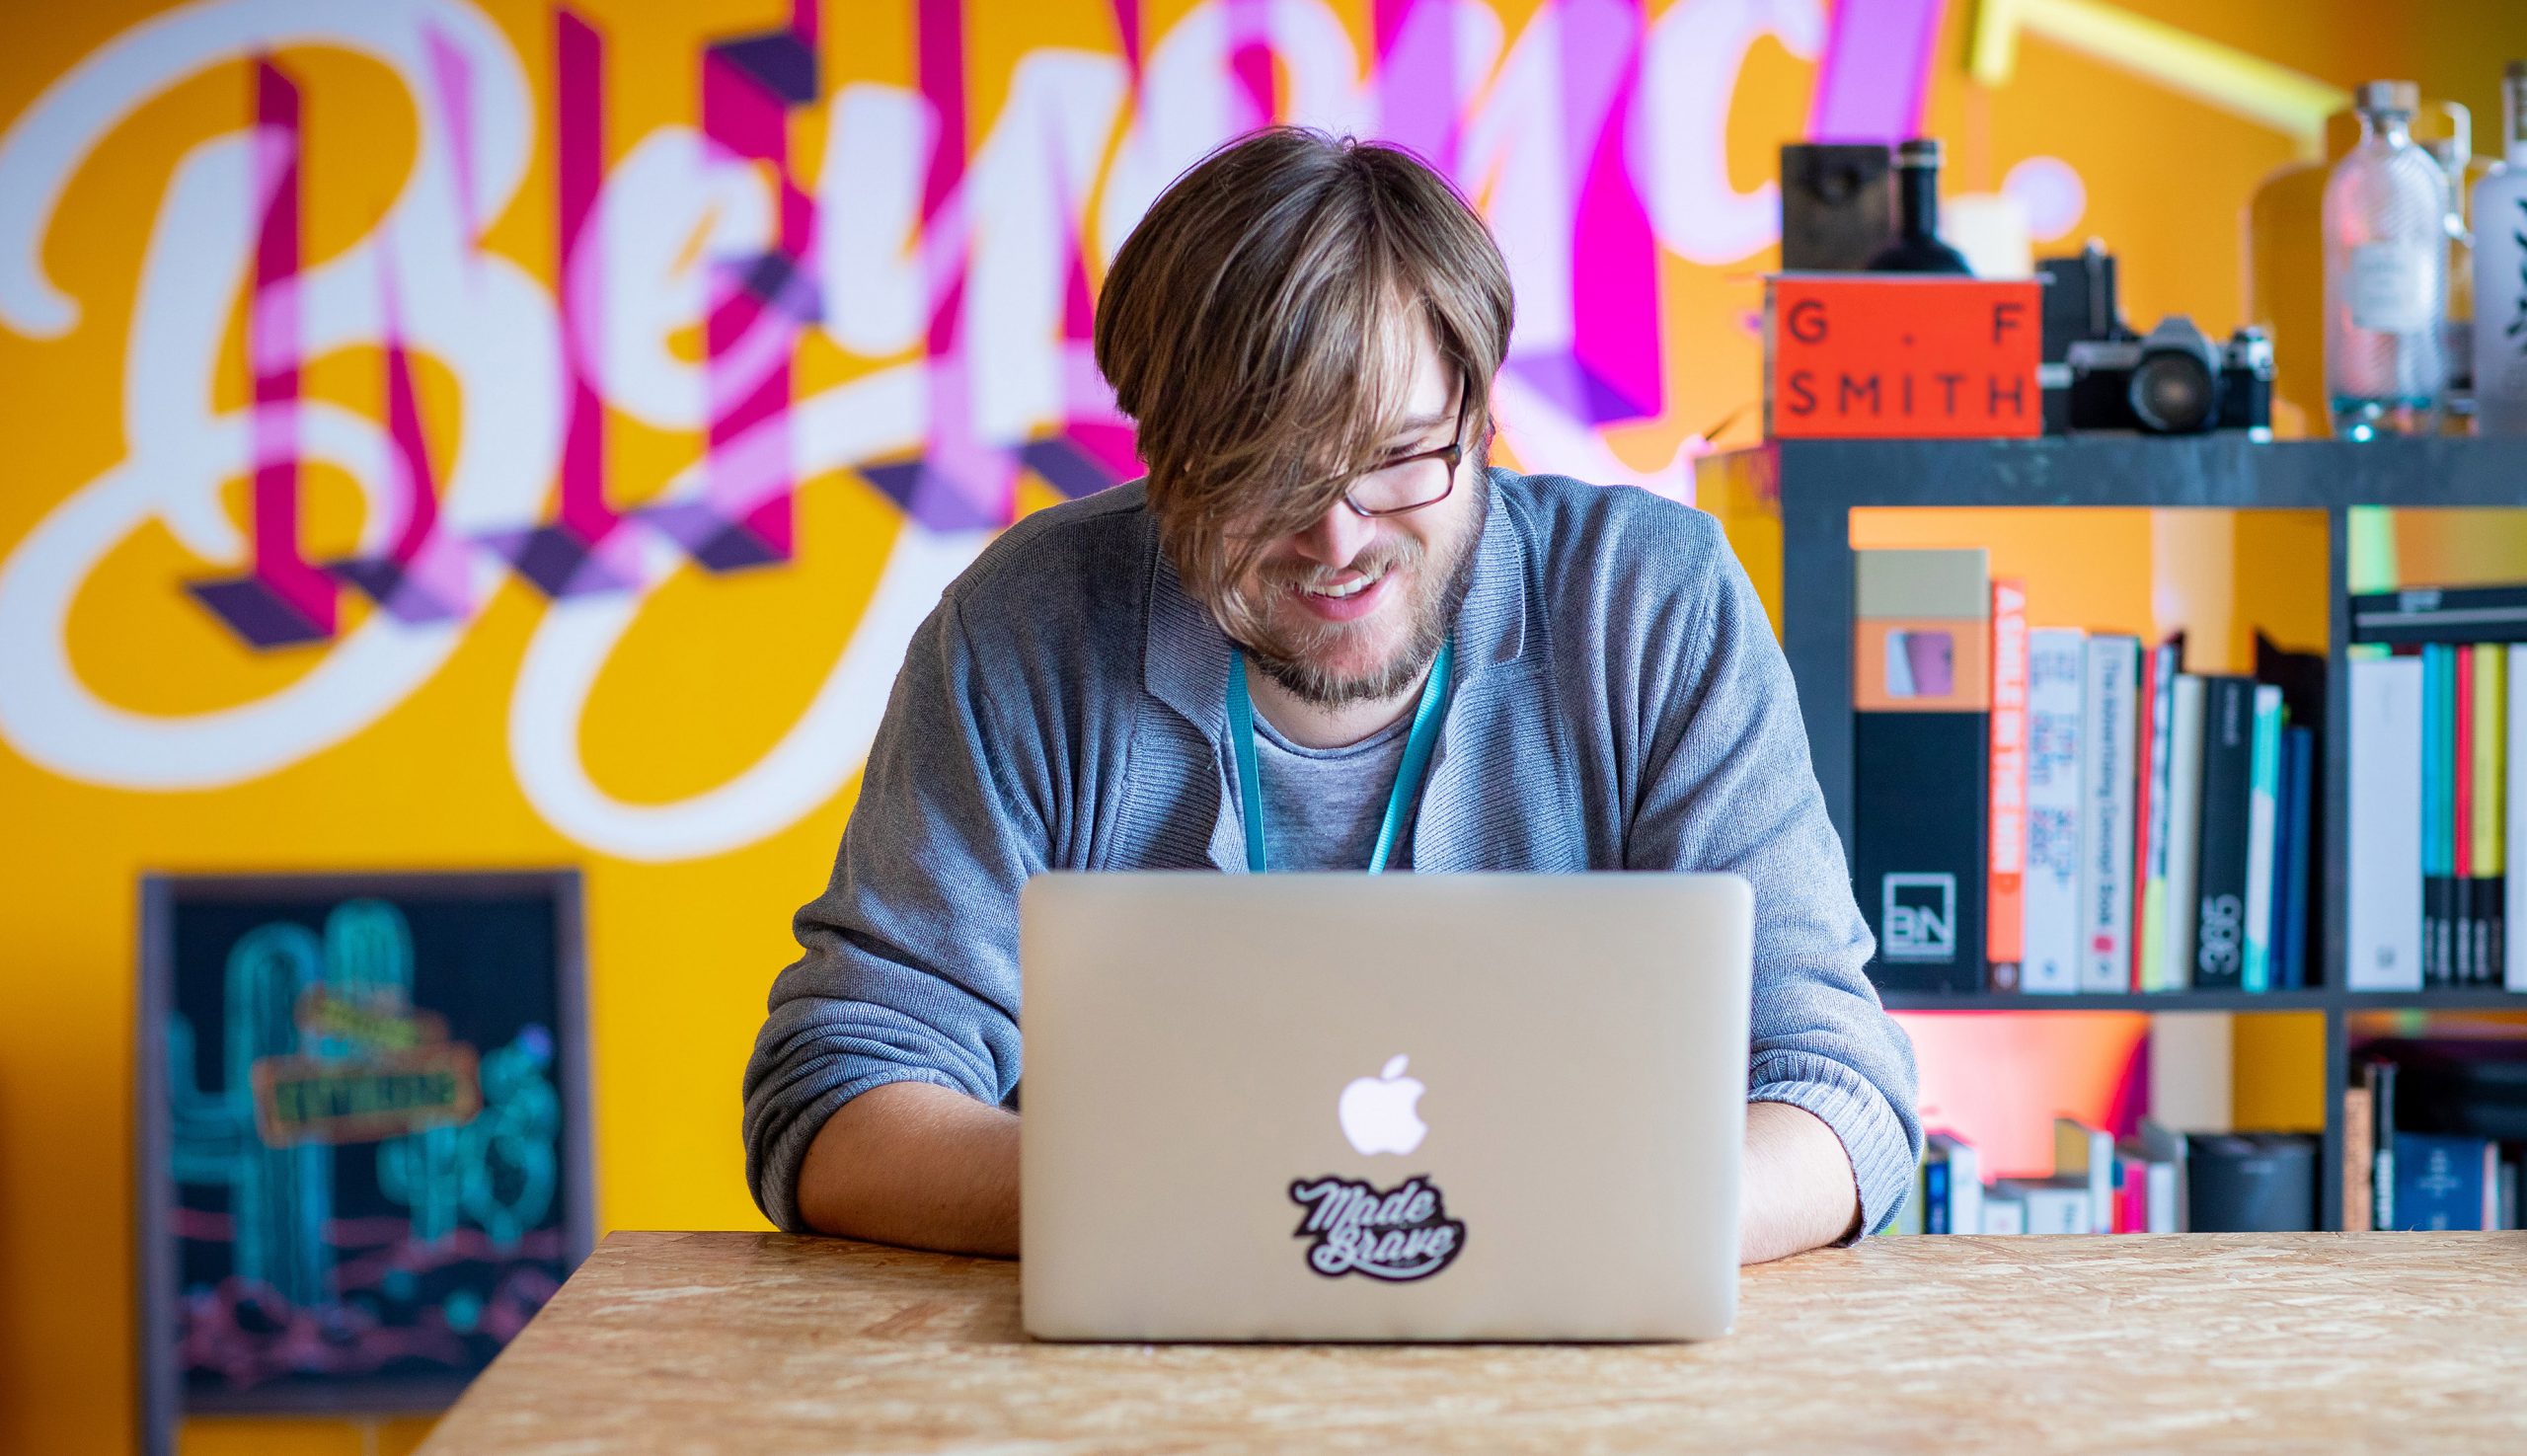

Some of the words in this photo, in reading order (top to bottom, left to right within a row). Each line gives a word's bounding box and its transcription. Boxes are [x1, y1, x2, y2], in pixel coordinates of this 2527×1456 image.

[1789, 372, 2024, 416] SMITH
[1996, 585, 2025, 611] A
[1995, 615, 2024, 708] SMILE
[1994, 710, 2023, 746] IN
[2097, 696, 2118, 798] Advertising
[1993, 751, 2022, 806] THE
[2097, 805, 2118, 874] Concept
[2100, 881, 2118, 926] Book
[2199, 894, 2242, 975] 365
[1295, 1181, 1435, 1231] Made
[1311, 1224, 1456, 1277] Brave
